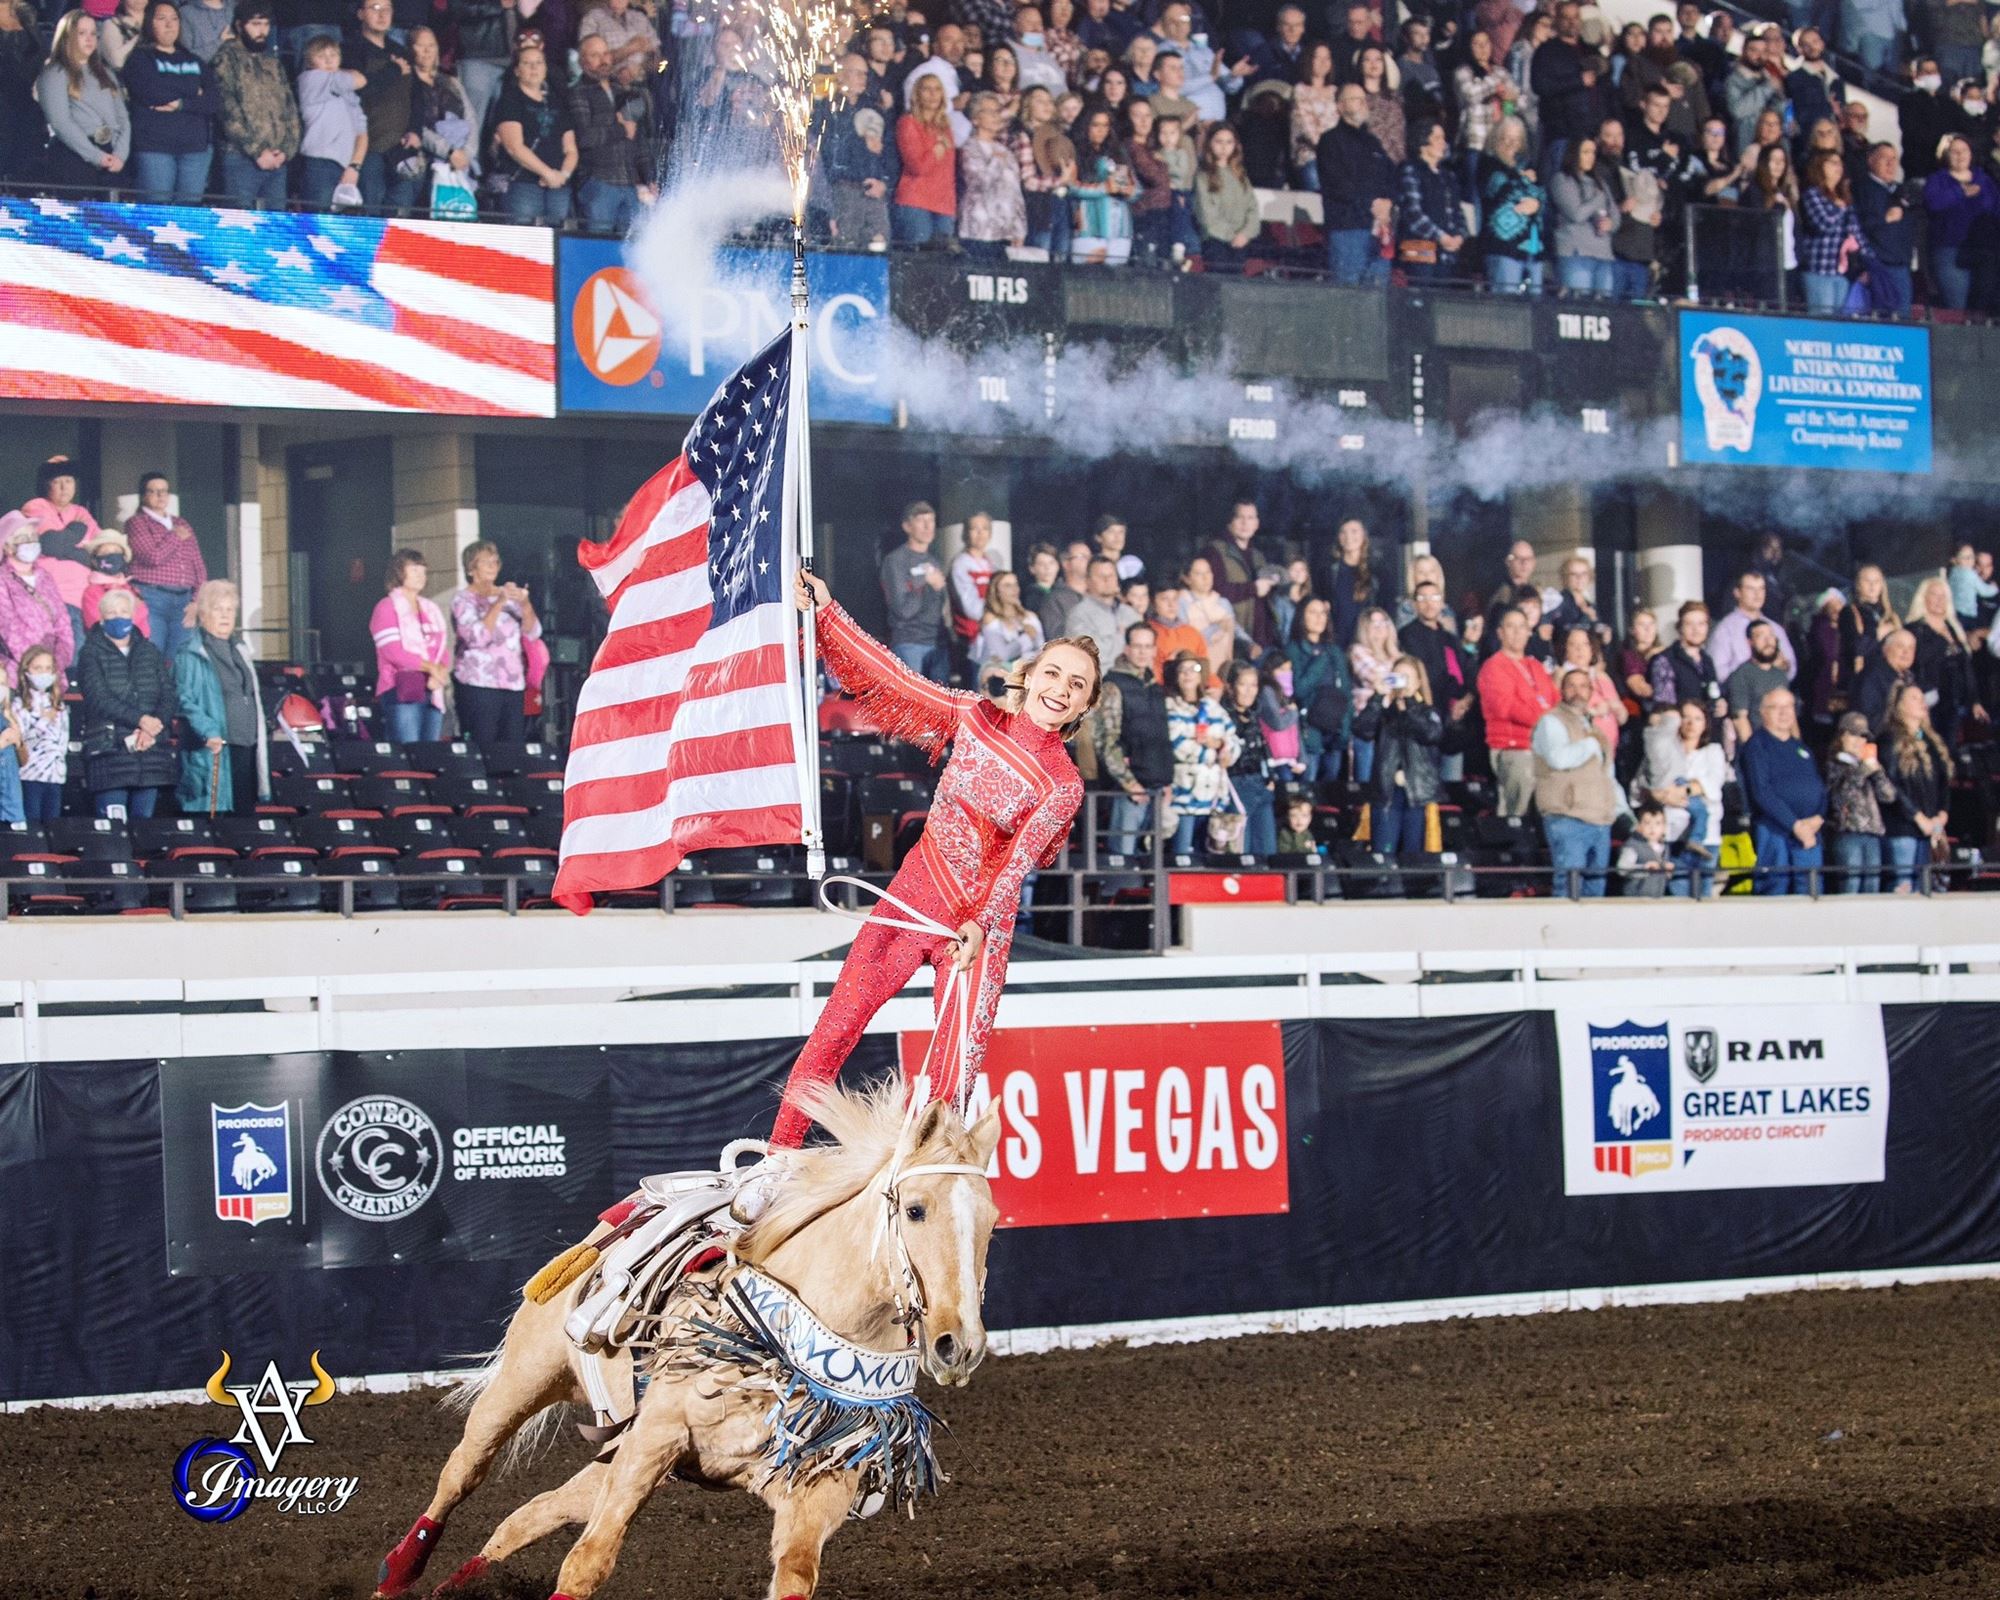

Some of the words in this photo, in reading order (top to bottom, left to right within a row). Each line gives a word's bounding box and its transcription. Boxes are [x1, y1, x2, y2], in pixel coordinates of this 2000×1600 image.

[996, 276, 1028, 304] FLS
[1583, 315, 1611, 341] FLS
[1785, 339, 1833, 360] NORTH
[1836, 341, 1904, 363] AMERICAN
[1792, 358, 1899, 381] INTERNATIONAL
[1768, 375, 1844, 395] LIVESTOCK
[1846, 379, 1922, 400] EXPOSITION
[1785, 411, 1804, 426] and
[1806, 412, 1824, 427] the
[1826, 412, 1857, 429] North
[1860, 414, 1909, 431] American
[1791, 428, 1867, 450] Championship
[1868, 432, 1903, 449] Rodeo
[1591, 1034, 1668, 1050] PRORODEO
[1727, 1039, 1825, 1062] RAM
[1683, 1090, 1773, 1117] GREAT
[1782, 1086, 1870, 1113] LAKES
[217, 1116, 285, 1130] PRORODEO
[334, 1102, 430, 1139] COWBOY
[1064, 1064, 1279, 1174] VEGAS
[453, 1125, 565, 1148] OFFICIAL
[1683, 1127, 1762, 1142] PRORODEO
[1767, 1124, 1826, 1140] CIRCUIT
[453, 1145, 566, 1167] NETWORK
[454, 1166, 476, 1181] OF
[480, 1163, 567, 1179] PRORODEO
[336, 1182, 429, 1215] CHANNEL
